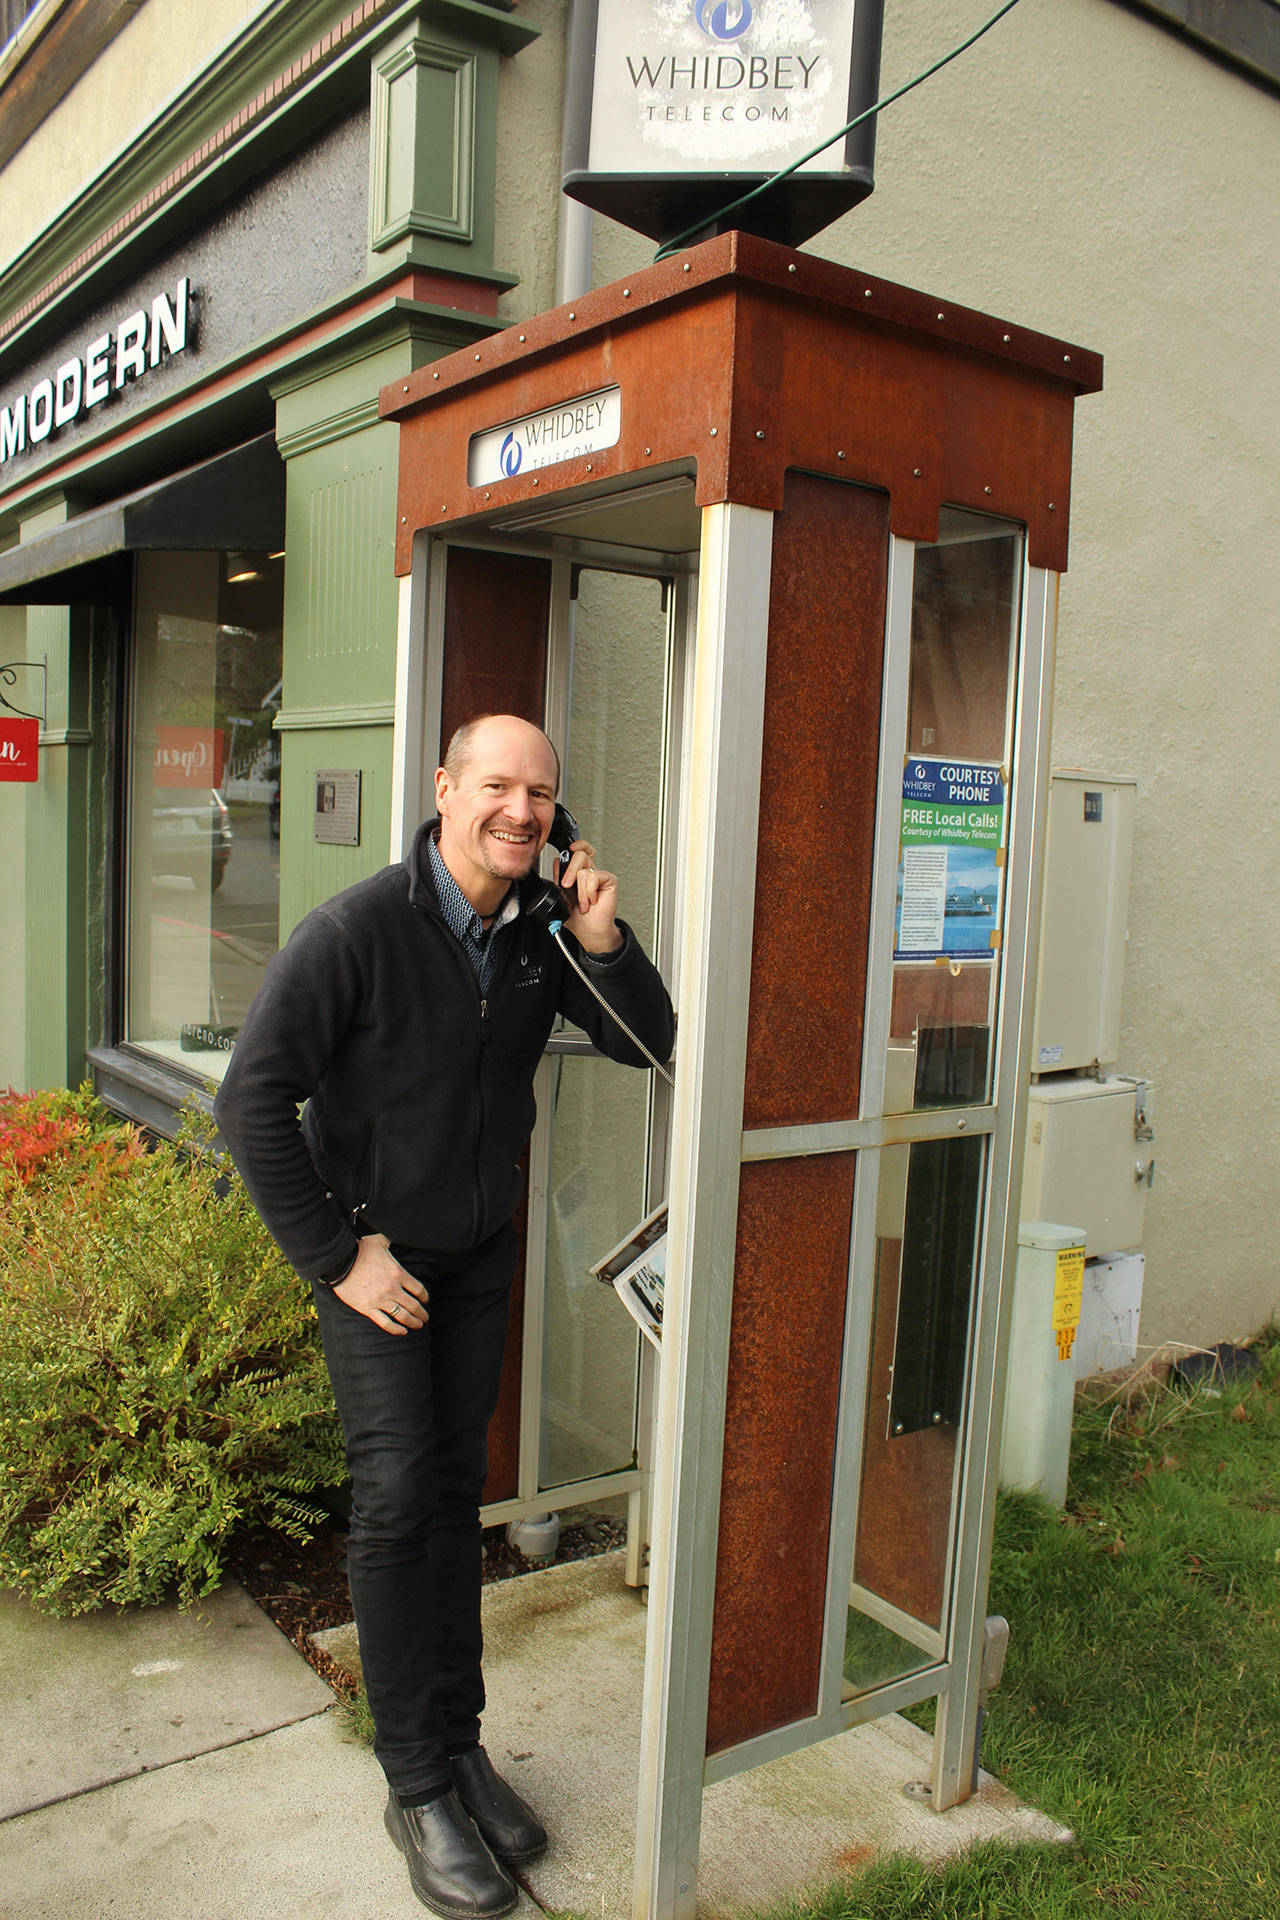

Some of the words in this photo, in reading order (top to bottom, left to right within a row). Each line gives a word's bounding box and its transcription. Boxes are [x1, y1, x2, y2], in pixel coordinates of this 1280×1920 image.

[625, 55, 821, 90] WHIDBEY
[646, 105, 790, 122] TELECOM
[0, 276, 190, 464] MODERN
[525, 398, 608, 449] WHIDBEY
[939, 766, 1001, 785] COURTESY
[903, 780, 937, 792] WHIDBEY
[948, 784, 990, 802] PHONE
[903, 808, 933, 825] FREE
[935, 810, 966, 827] Local
[968, 812, 999, 829] Calls!
[902, 825, 933, 838] Courtesy
[933, 827, 942, 838] of
[941, 828, 971, 840] Whidbey
[971, 829, 998, 840] Telecom
